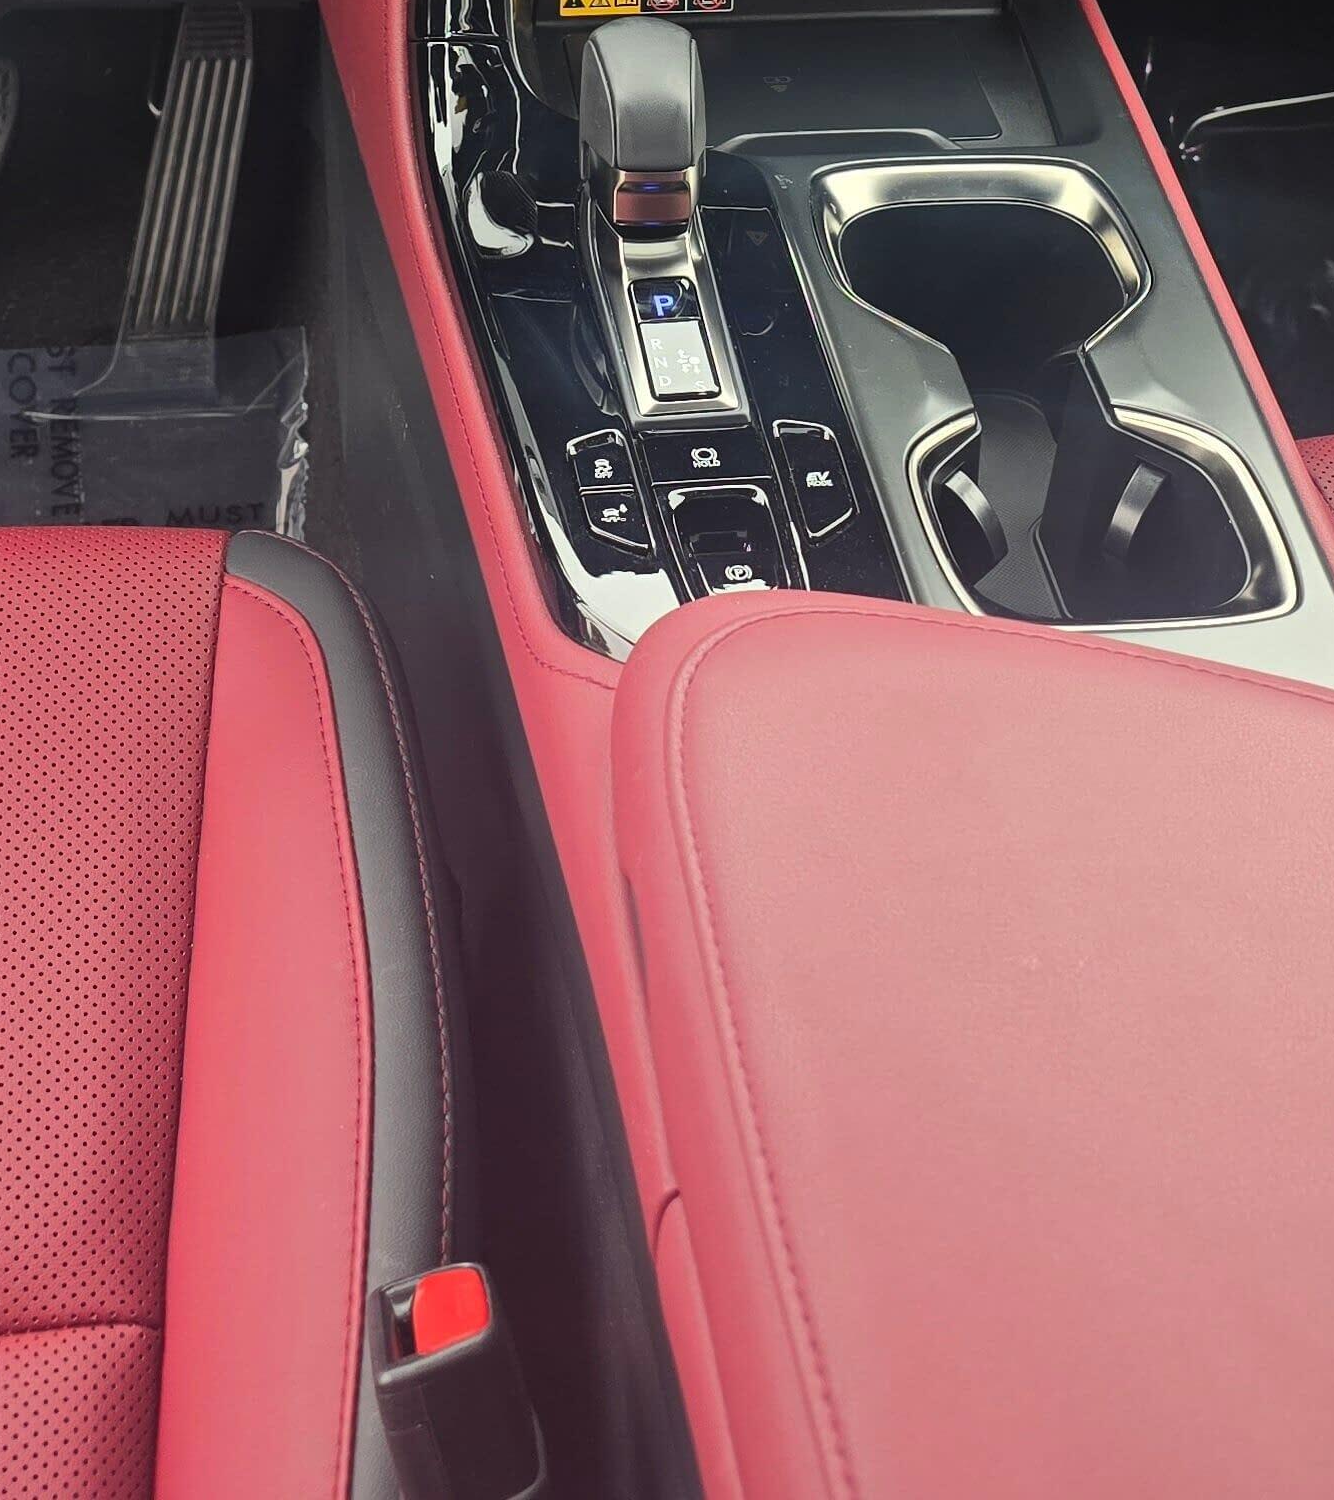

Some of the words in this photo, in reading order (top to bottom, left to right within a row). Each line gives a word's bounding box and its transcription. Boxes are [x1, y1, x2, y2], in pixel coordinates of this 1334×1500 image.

[654, 294, 675, 317] P
[650, 338, 663, 350] R
[653, 356, 668, 369] N
[659, 375, 672, 387] D
[693, 380, 707, 391] S
[8, 353, 40, 460] COVER
[693, 459, 720, 469] HOLD
[594, 471, 613, 479] OFF
[806, 471, 829, 481] EV
[168, 501, 265, 526] MUST
